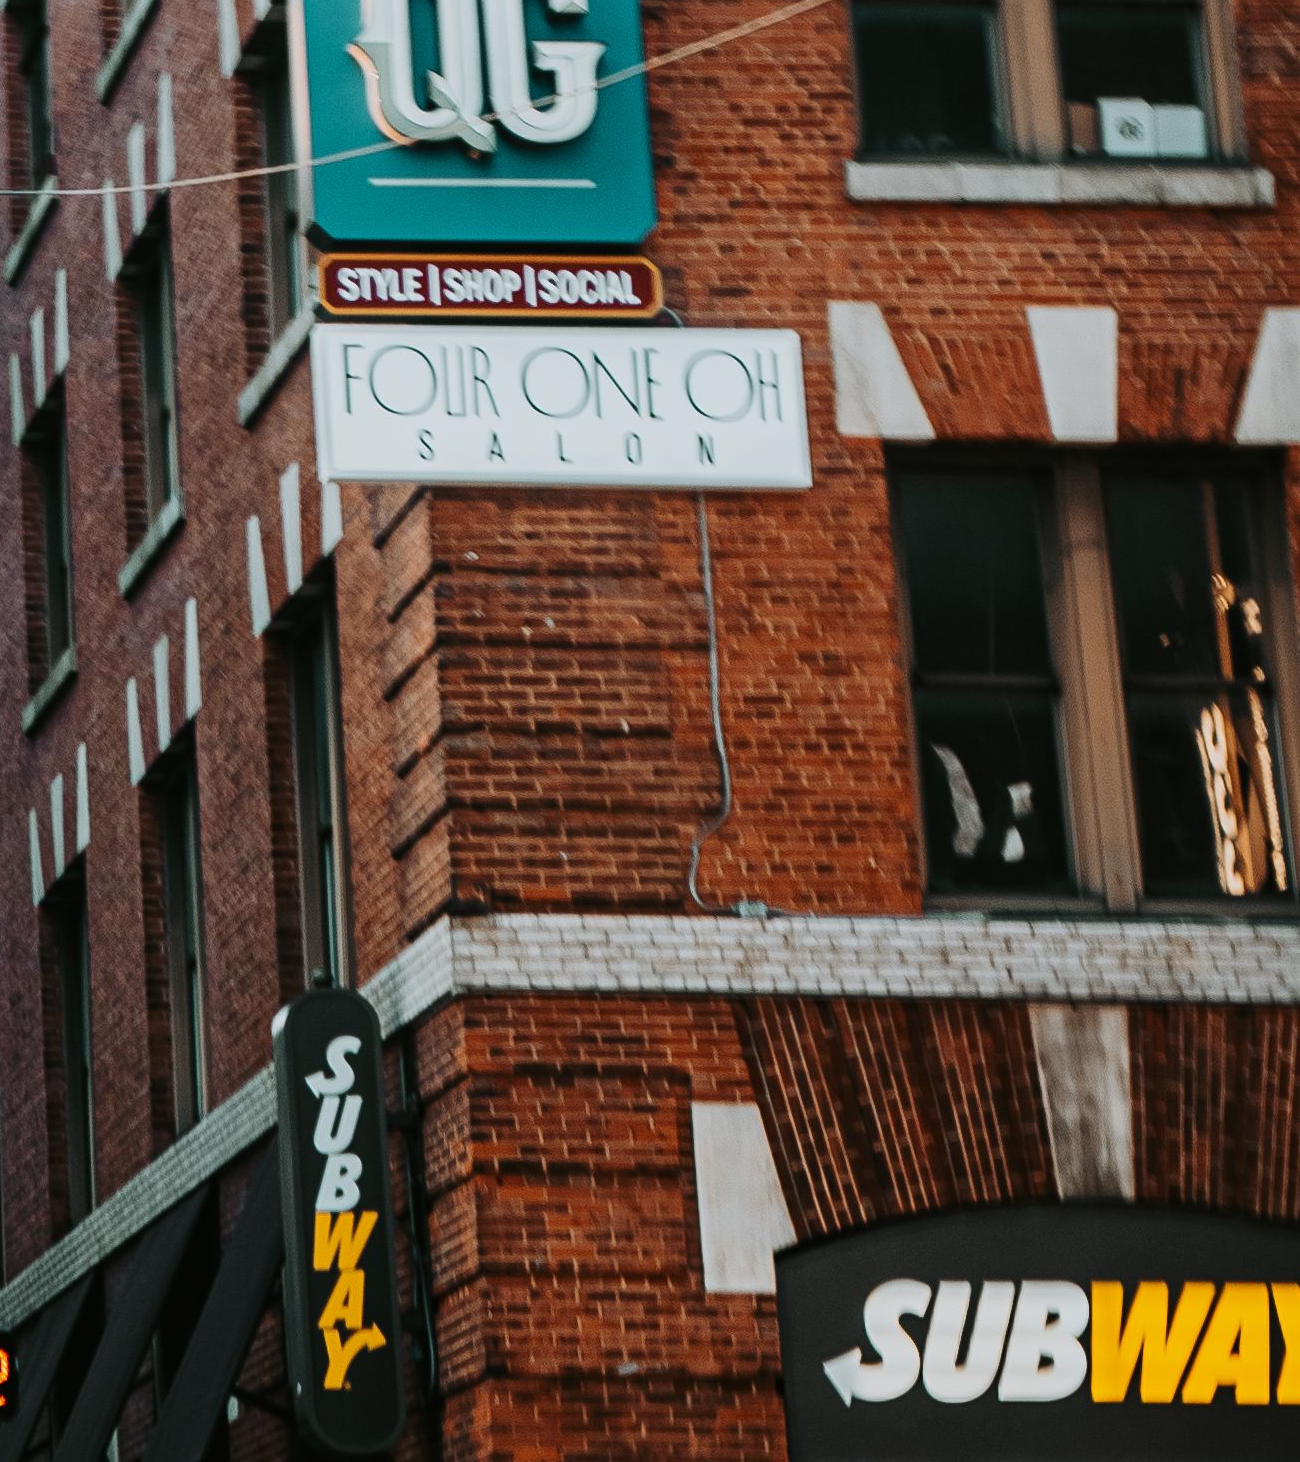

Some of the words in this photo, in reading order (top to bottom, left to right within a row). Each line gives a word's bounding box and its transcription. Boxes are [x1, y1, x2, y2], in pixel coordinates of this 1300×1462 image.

[337, 268, 424, 303] STYLE
[443, 268, 521, 304] SHOP
[538, 269, 642, 306] SOCIAL
[343, 343, 500, 418] FOUR
[521, 346, 663, 420] ONE
[685, 349, 783, 423] OH
[417, 430, 716, 465] SALON
[306, 1035, 386, 1389] SUBWAY
